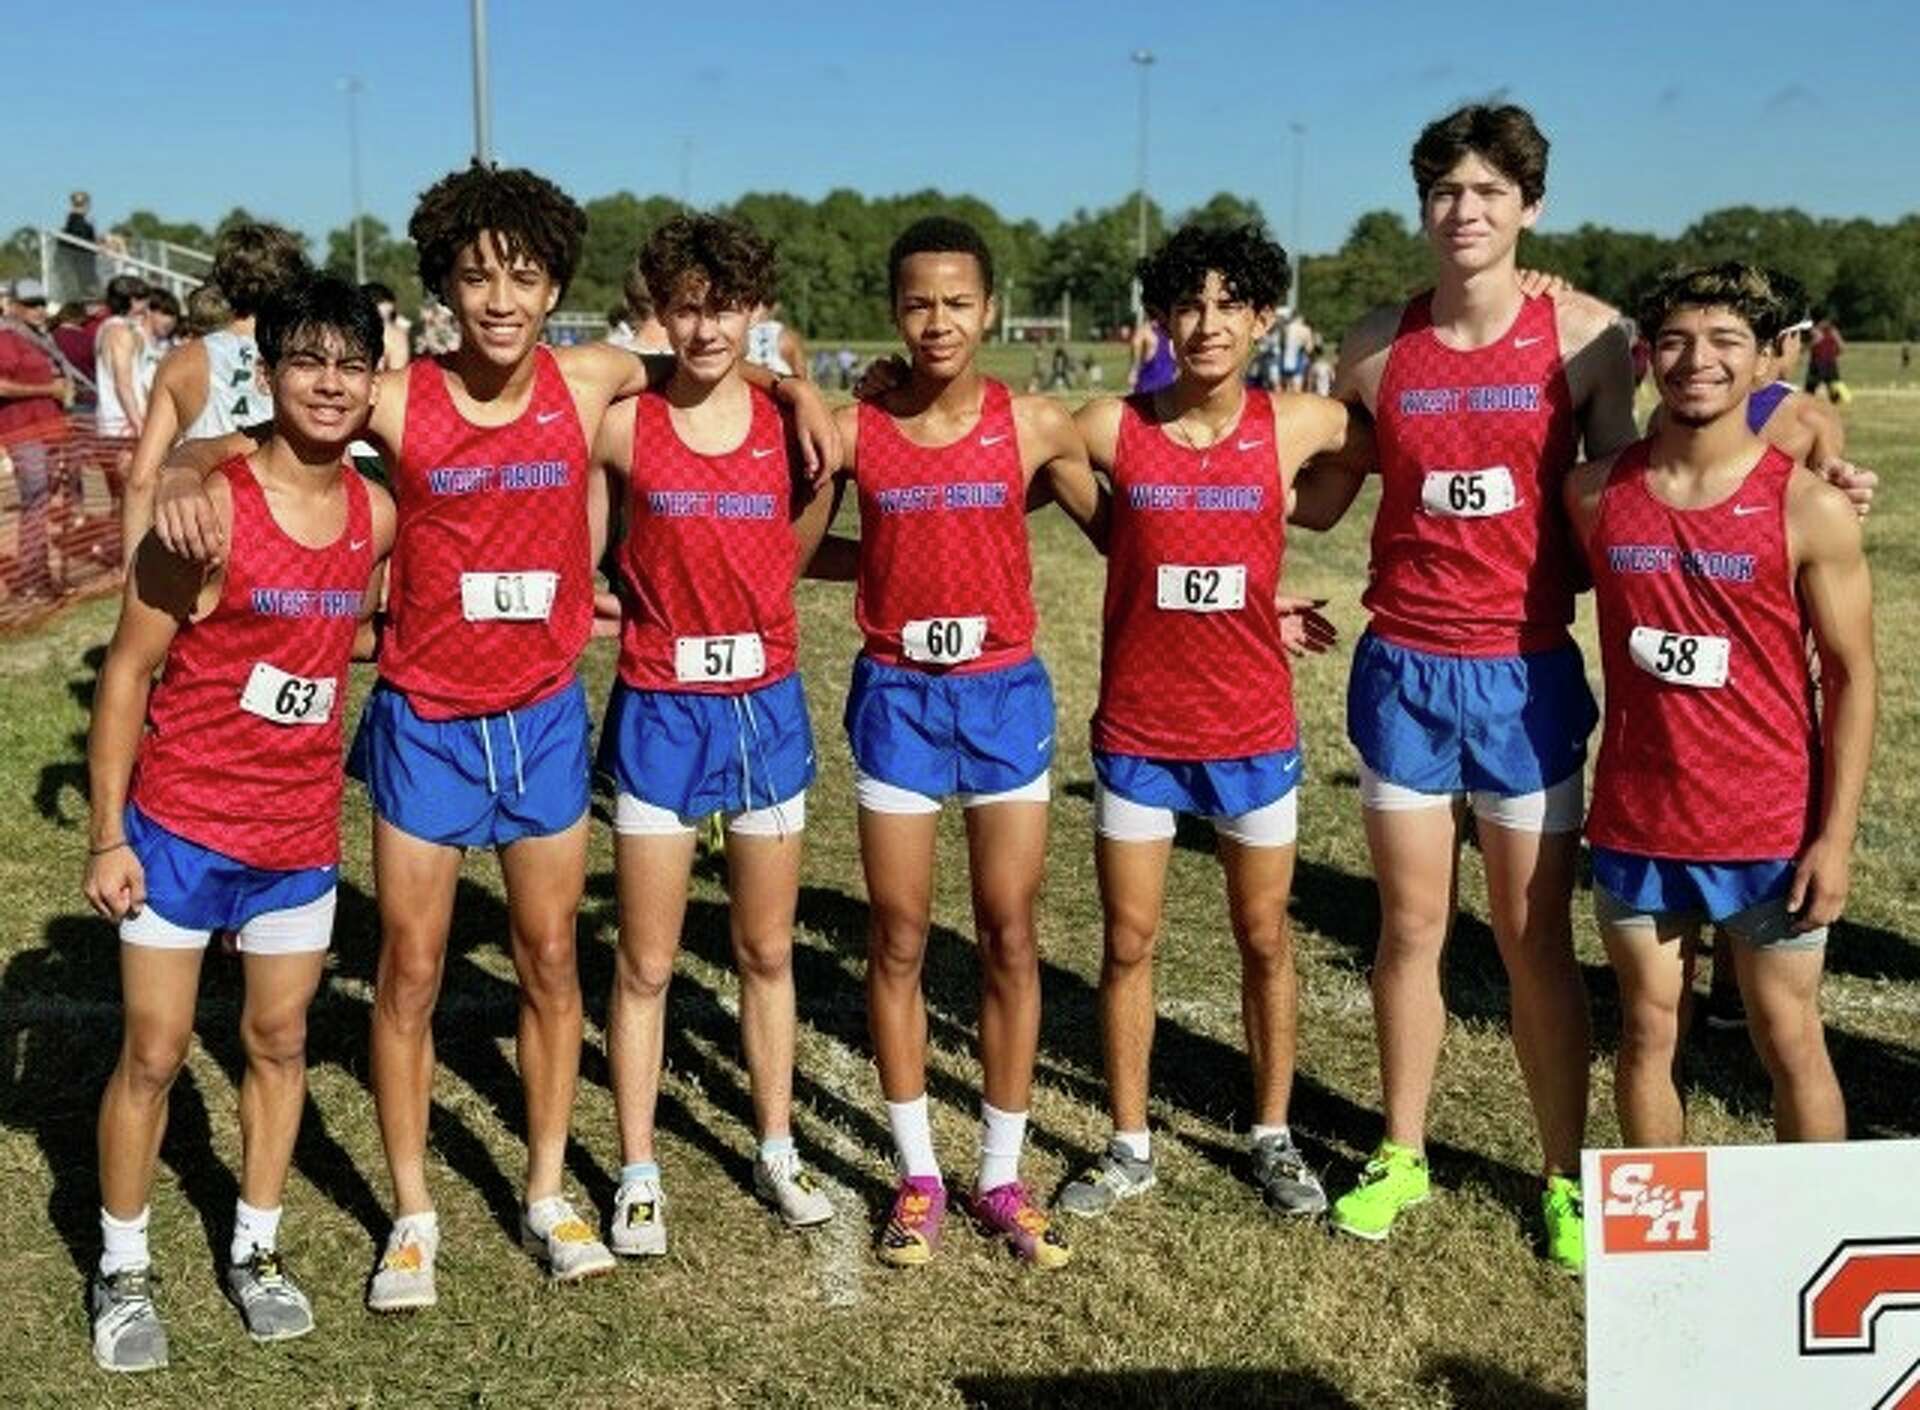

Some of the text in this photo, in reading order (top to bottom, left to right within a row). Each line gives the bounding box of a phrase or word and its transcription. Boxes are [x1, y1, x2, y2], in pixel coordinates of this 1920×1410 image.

[1401, 384, 1540, 416] WEST BROOK
[427, 460, 567, 495] WEST BROOK
[1448, 474, 1486, 511] 65
[649, 491, 774, 520] WEST BROOK
[876, 482, 1008, 516] WEST BROOK
[1129, 484, 1264, 513] WEST BROOK
[1609, 546, 1757, 582] WEST BROOK
[251, 588, 317, 618] WEST
[494, 575, 529, 612] 61
[1184, 569, 1220, 604] 62
[926, 620, 963, 657] 60
[1655, 635, 1699, 676] 58
[704, 639, 736, 676] 57
[275, 678, 318, 718] 63
